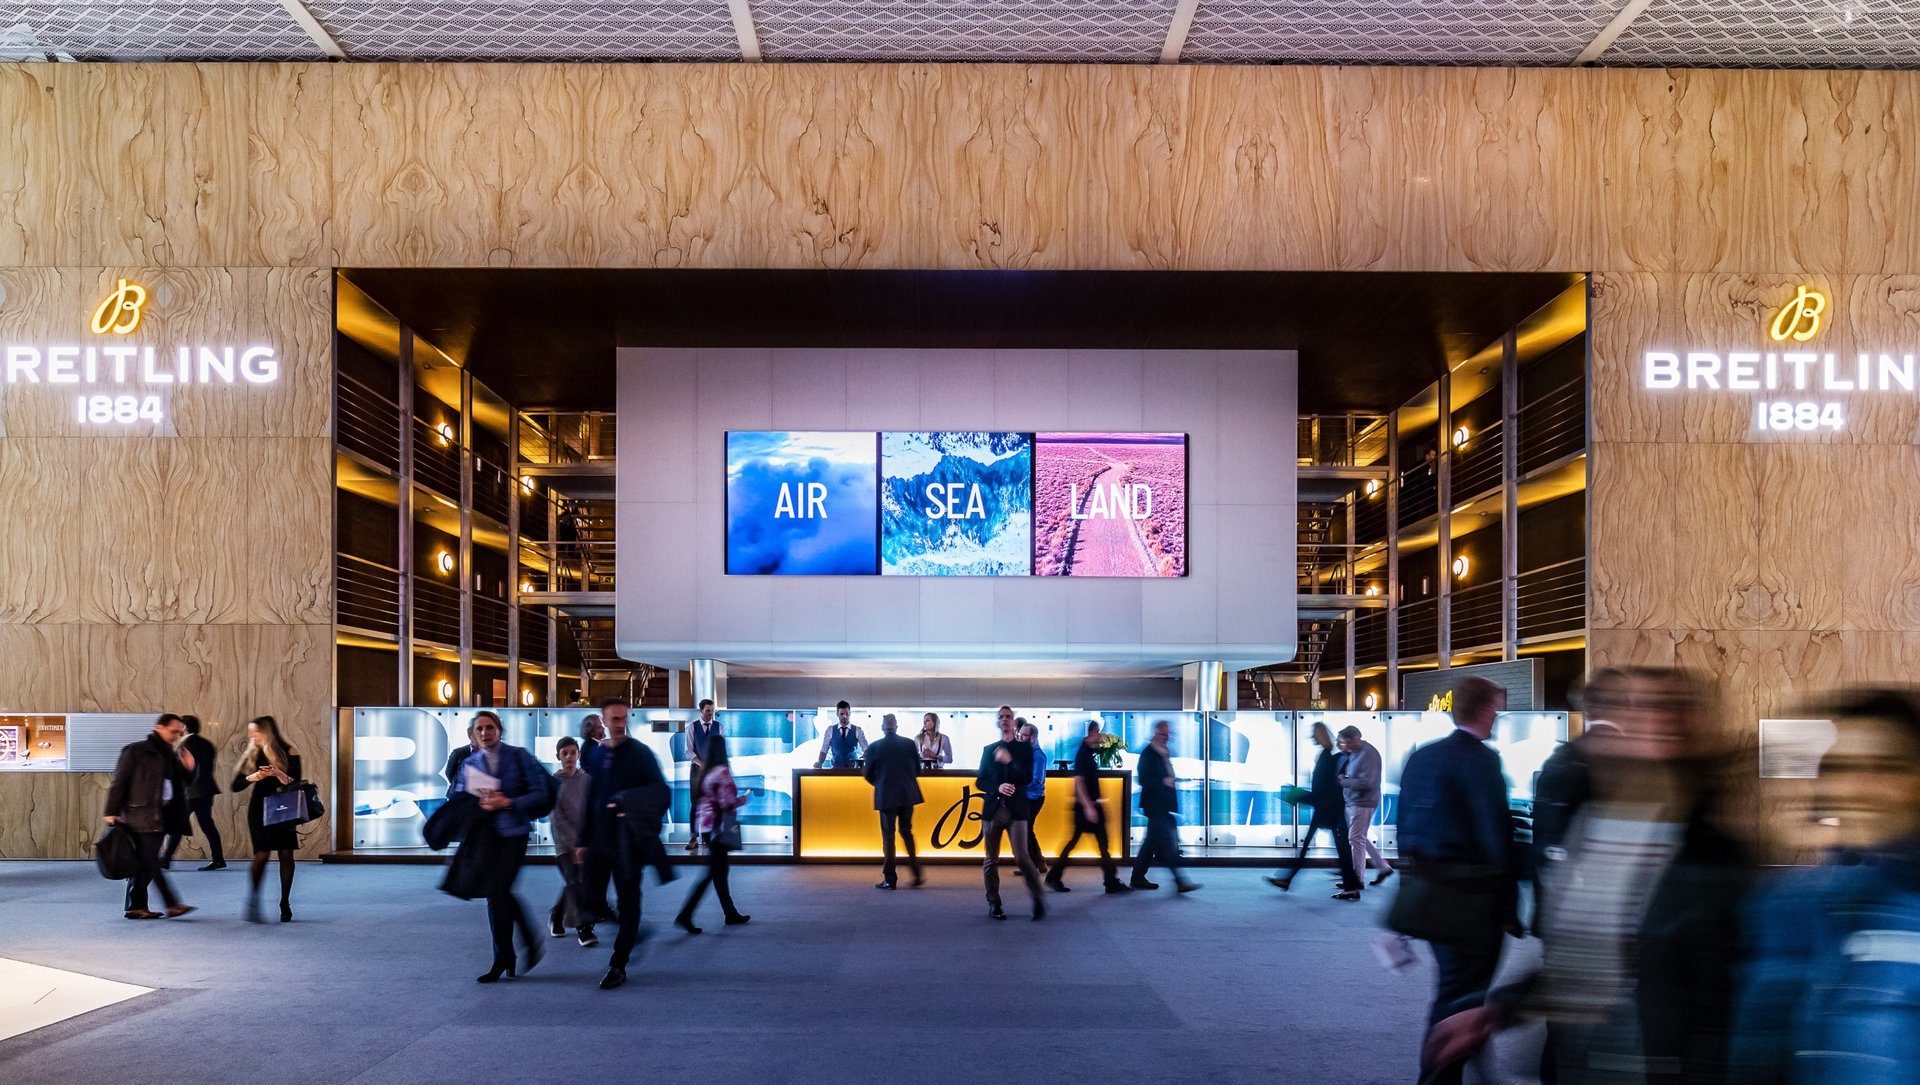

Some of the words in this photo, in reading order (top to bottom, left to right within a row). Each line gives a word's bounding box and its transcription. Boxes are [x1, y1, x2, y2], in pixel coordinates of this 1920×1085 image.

[90, 278, 146, 335] B
[1770, 285, 1826, 342] B
[6, 346, 279, 384] REITLING
[1644, 351, 1915, 391] BREITLIN
[77, 394, 164, 424] 1884
[1758, 401, 1844, 431] 1884
[774, 482, 828, 519] AIR
[925, 482, 986, 519] SEA
[1070, 483, 1152, 520] LAND
